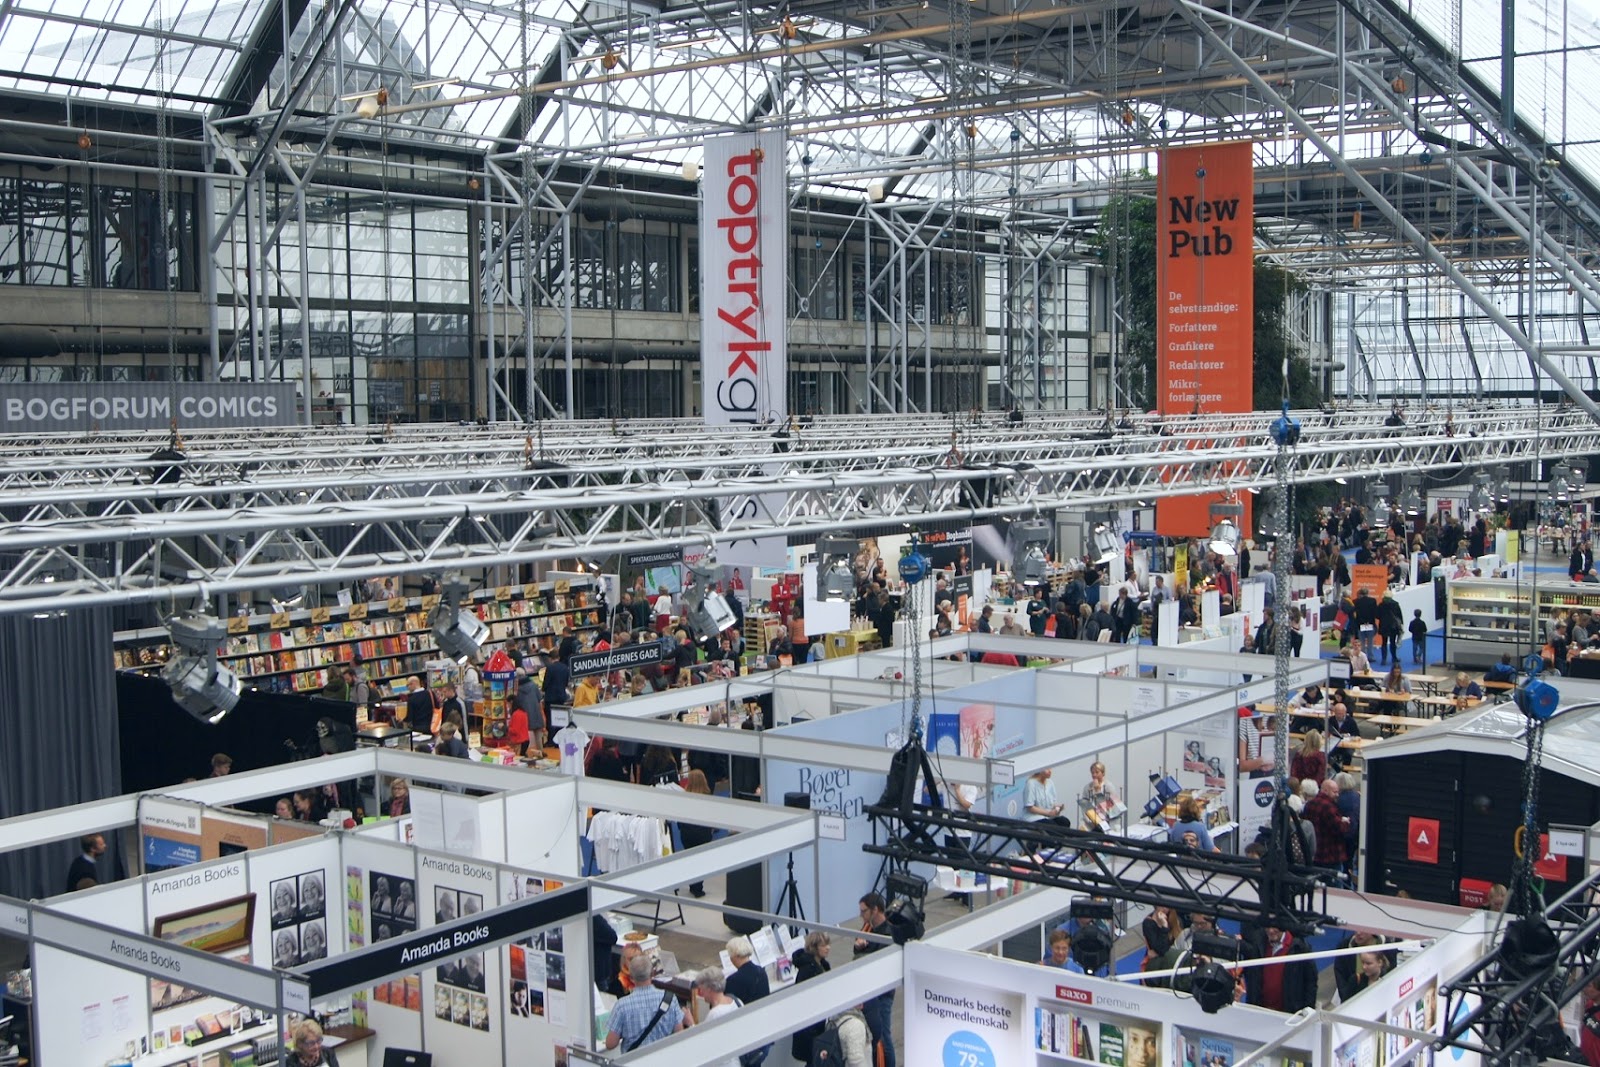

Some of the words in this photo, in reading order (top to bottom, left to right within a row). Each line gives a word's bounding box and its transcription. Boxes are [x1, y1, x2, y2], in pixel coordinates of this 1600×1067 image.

[1169, 195, 1240, 224] New
[1169, 226, 1233, 258] Pub
[1169, 291, 1182, 301] De
[1169, 302, 1238, 315] selvstændige:
[1169, 322, 1217, 333] Forfattere
[1169, 341, 1215, 351] Grafikere
[1169, 360, 1224, 370] Redaktører
[1169, 379, 1202, 389] Mikro-
[6, 397, 171, 421] BOGFORUM
[179, 396, 278, 418] COMICS
[573, 651, 638, 672] SANDALMAGERNES
[639, 649, 659, 661] GADE
[799, 767, 853, 803] Bøger
[151, 873, 201, 895] Amanda
[204, 863, 240, 883] Books
[422, 856, 461, 875] Amanda
[463, 863, 493, 881] Books
[110, 938, 149, 963] Amanda
[151, 951, 182, 973] Books
[400, 936, 451, 964] Amanda
[453, 923, 490, 947] Books
[923, 988, 975, 1011] Danmarks
[976, 999, 1012, 1019] bedste
[1059, 987, 1088, 1001] saxo
[1096, 995, 1140, 1012] premium
[927, 1002, 1009, 1031] bogmedlemskab
